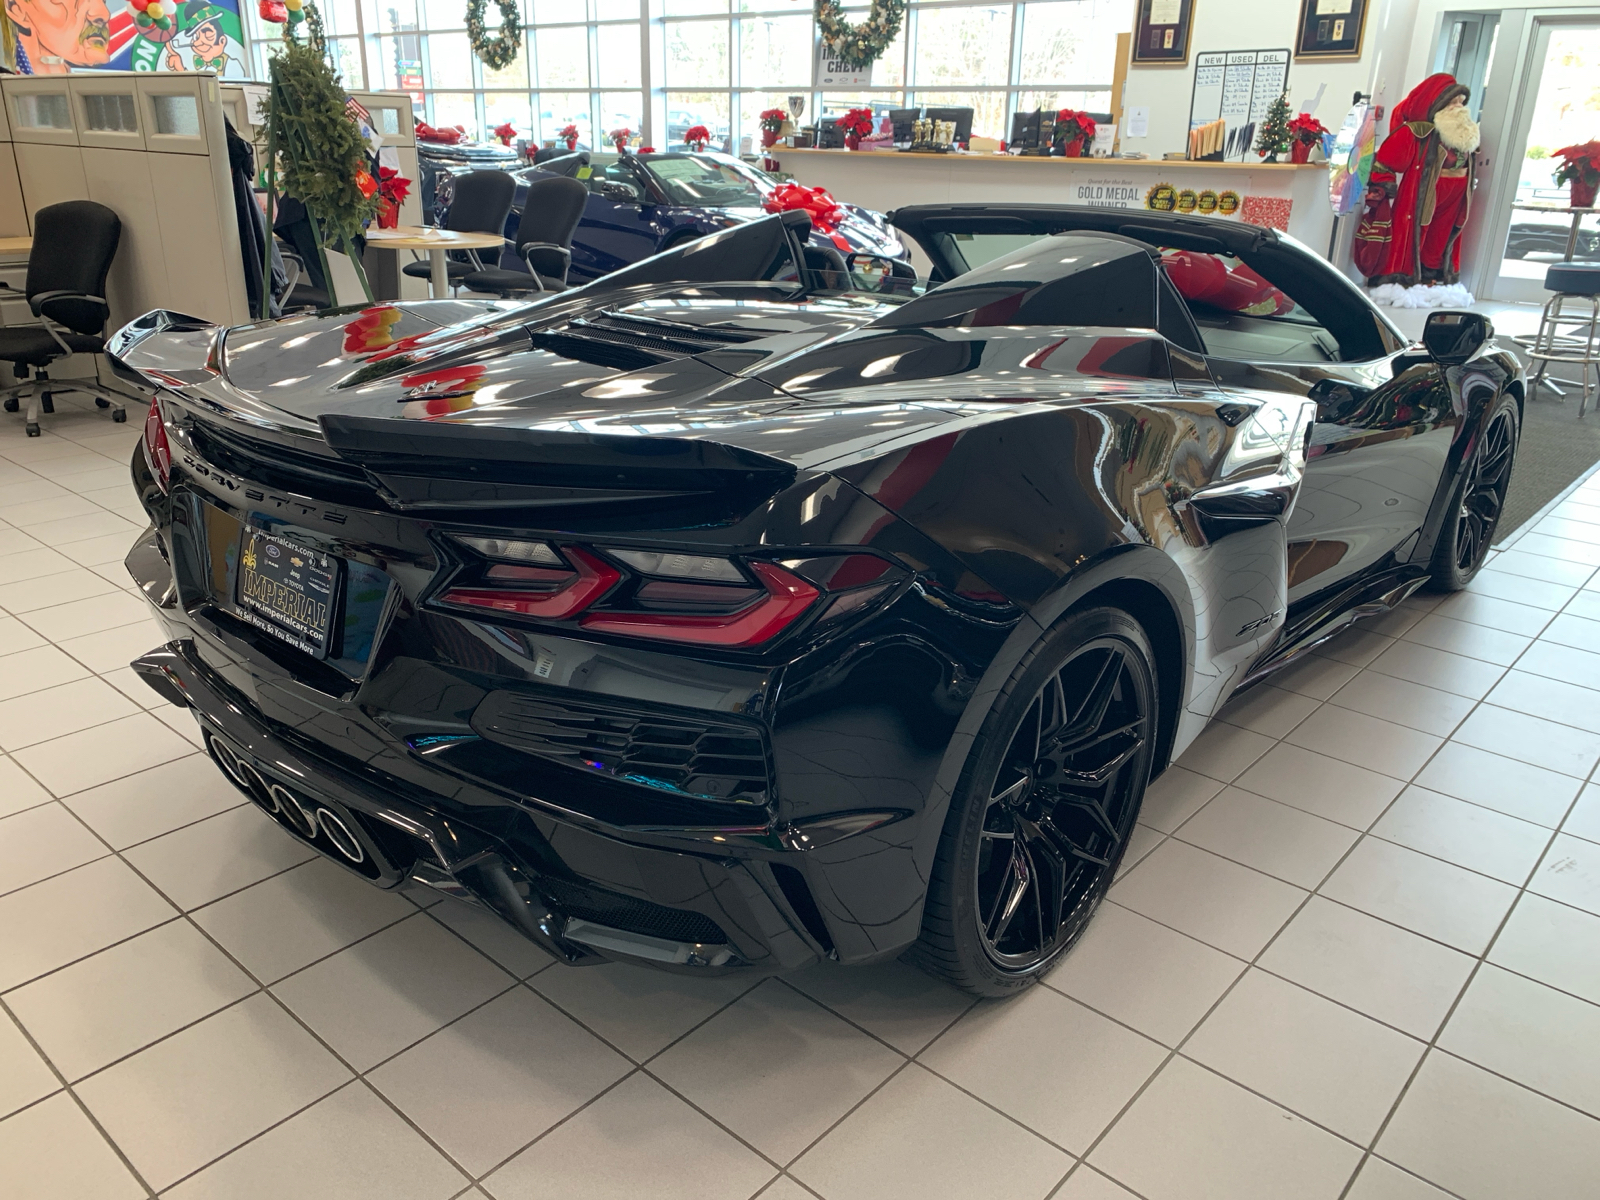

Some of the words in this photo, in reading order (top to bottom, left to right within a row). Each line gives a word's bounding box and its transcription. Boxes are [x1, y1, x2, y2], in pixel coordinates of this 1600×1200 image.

[1204, 57, 1223, 65] NEW
[1231, 55, 1254, 63] USED
[1263, 55, 1279, 63] DEL
[1102, 178, 1111, 186] for
[1077, 185, 1103, 199] GOLD
[1105, 186, 1140, 201] MEDAL
[183, 454, 348, 526] CORVETTE
[268, 560, 279, 569] RAM
[288, 580, 304, 592] TOYOTA
[243, 567, 326, 633] IMPERIAL
[235, 606, 244, 617] We
[243, 611, 253, 622] Sell
[252, 617, 267, 632] More,
[266, 624, 275, 635] So
[274, 628, 285, 640] You
[285, 634, 299, 648] Save
[299, 641, 314, 656] More
